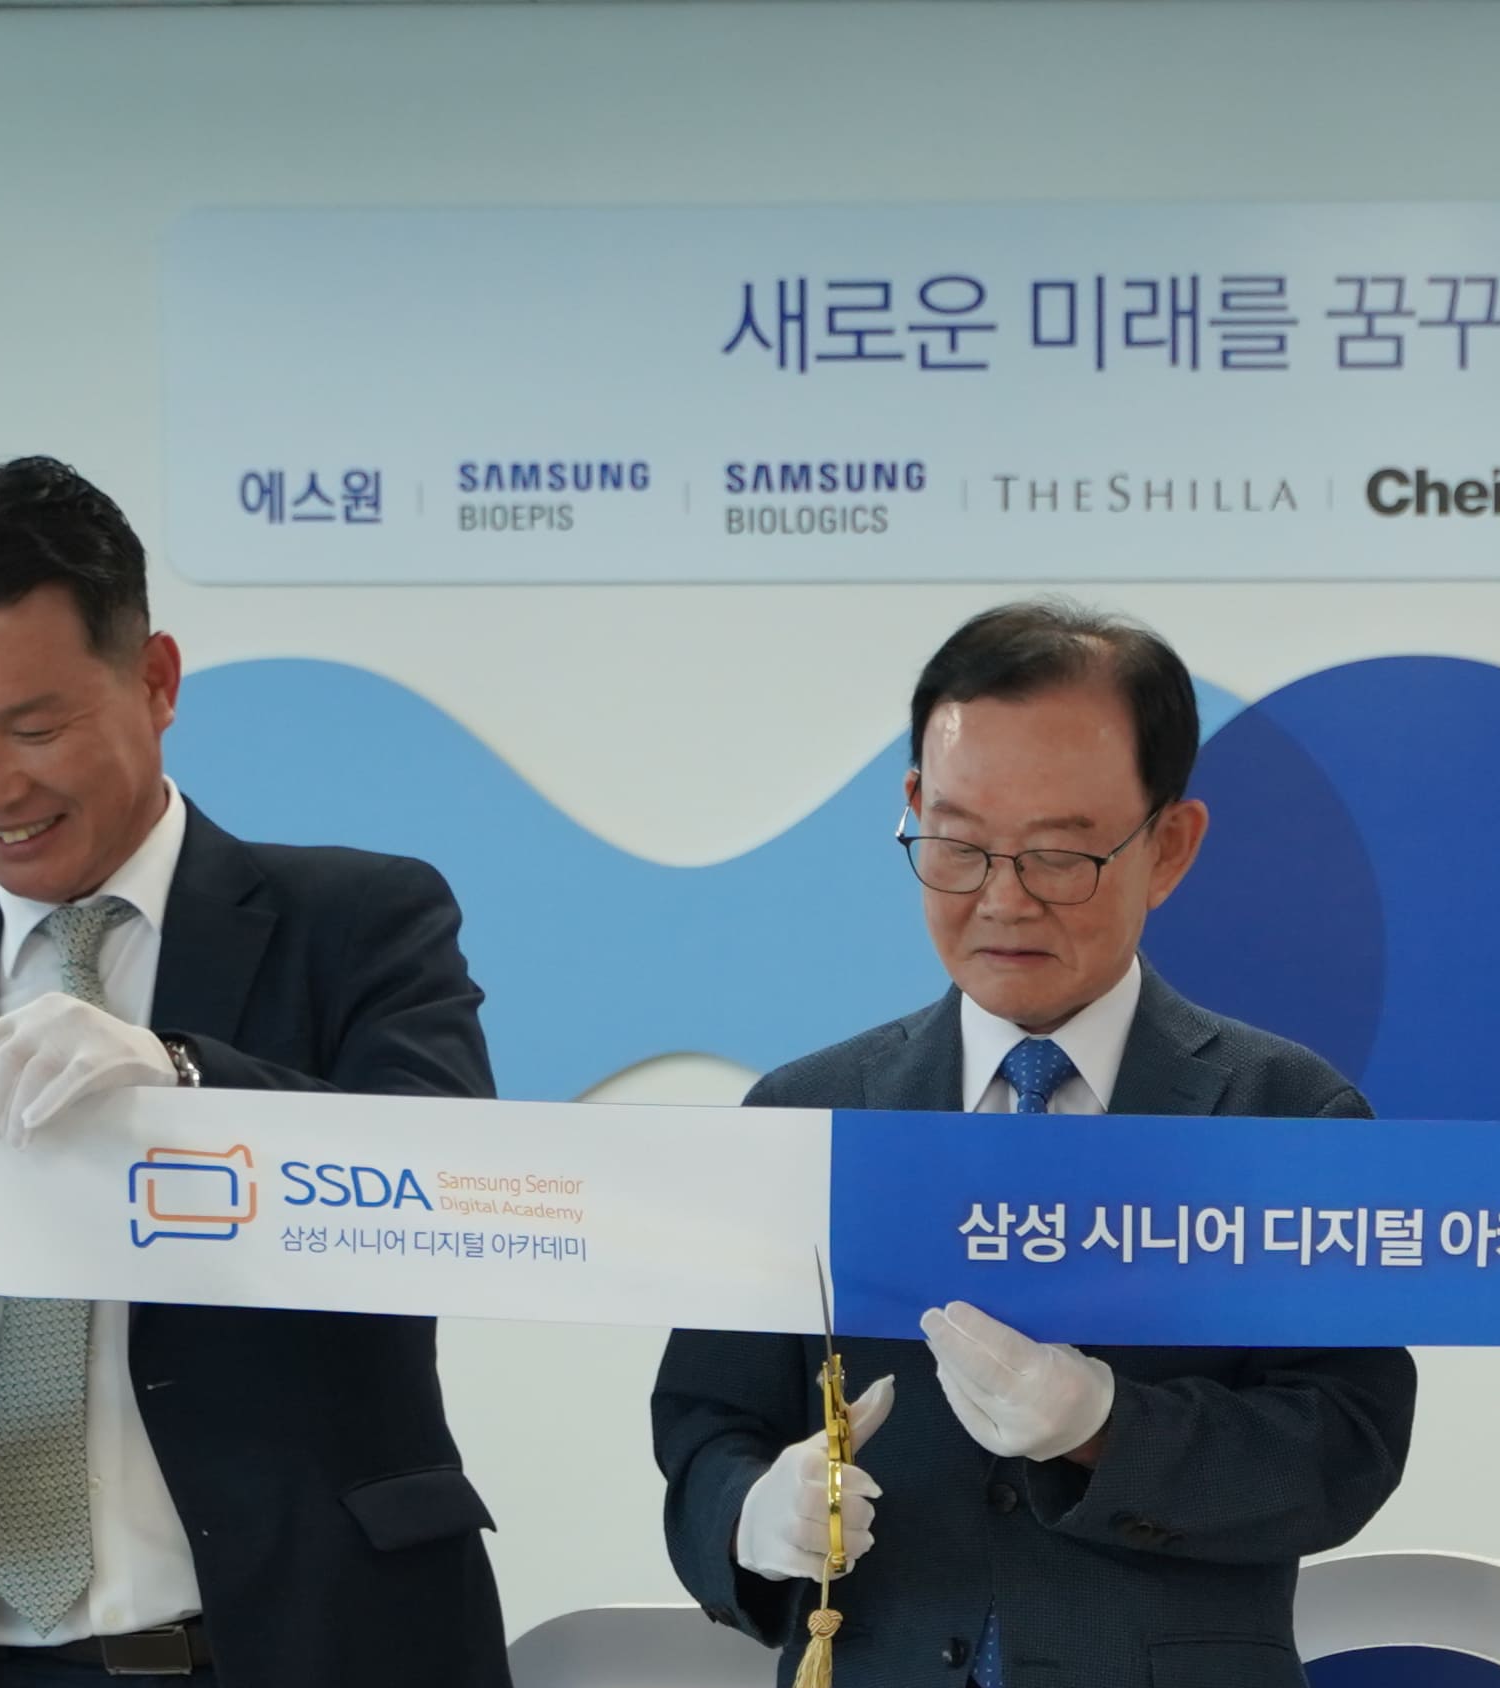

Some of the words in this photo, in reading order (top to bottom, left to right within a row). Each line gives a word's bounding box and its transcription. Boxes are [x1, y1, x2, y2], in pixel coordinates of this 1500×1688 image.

[722, 275, 997, 375] 새로운
[1030, 273, 1300, 373] 미래를
[458, 461, 651, 493] SAMSUNG
[724, 461, 927, 494] SAMSUNG
[239, 469, 384, 525] 에스원
[458, 504, 575, 533] BIOEPIS
[725, 505, 890, 536] BIOLOGICS
[280, 1161, 433, 1211] SSDA
[437, 1171, 521, 1195] Samsung
[526, 1174, 583, 1195] Senior
[440, 1196, 499, 1219] Digital
[501, 1199, 583, 1223] Academy
[280, 1227, 328, 1253] 삼성
[334, 1229, 406, 1255] 시니어
[414, 1231, 485, 1259] 디지털
[491, 1234, 587, 1262] 아카데미
[958, 1203, 1066, 1262] 삼성
[1082, 1204, 1246, 1265] 시니어
[1263, 1206, 1424, 1267] 디지털
